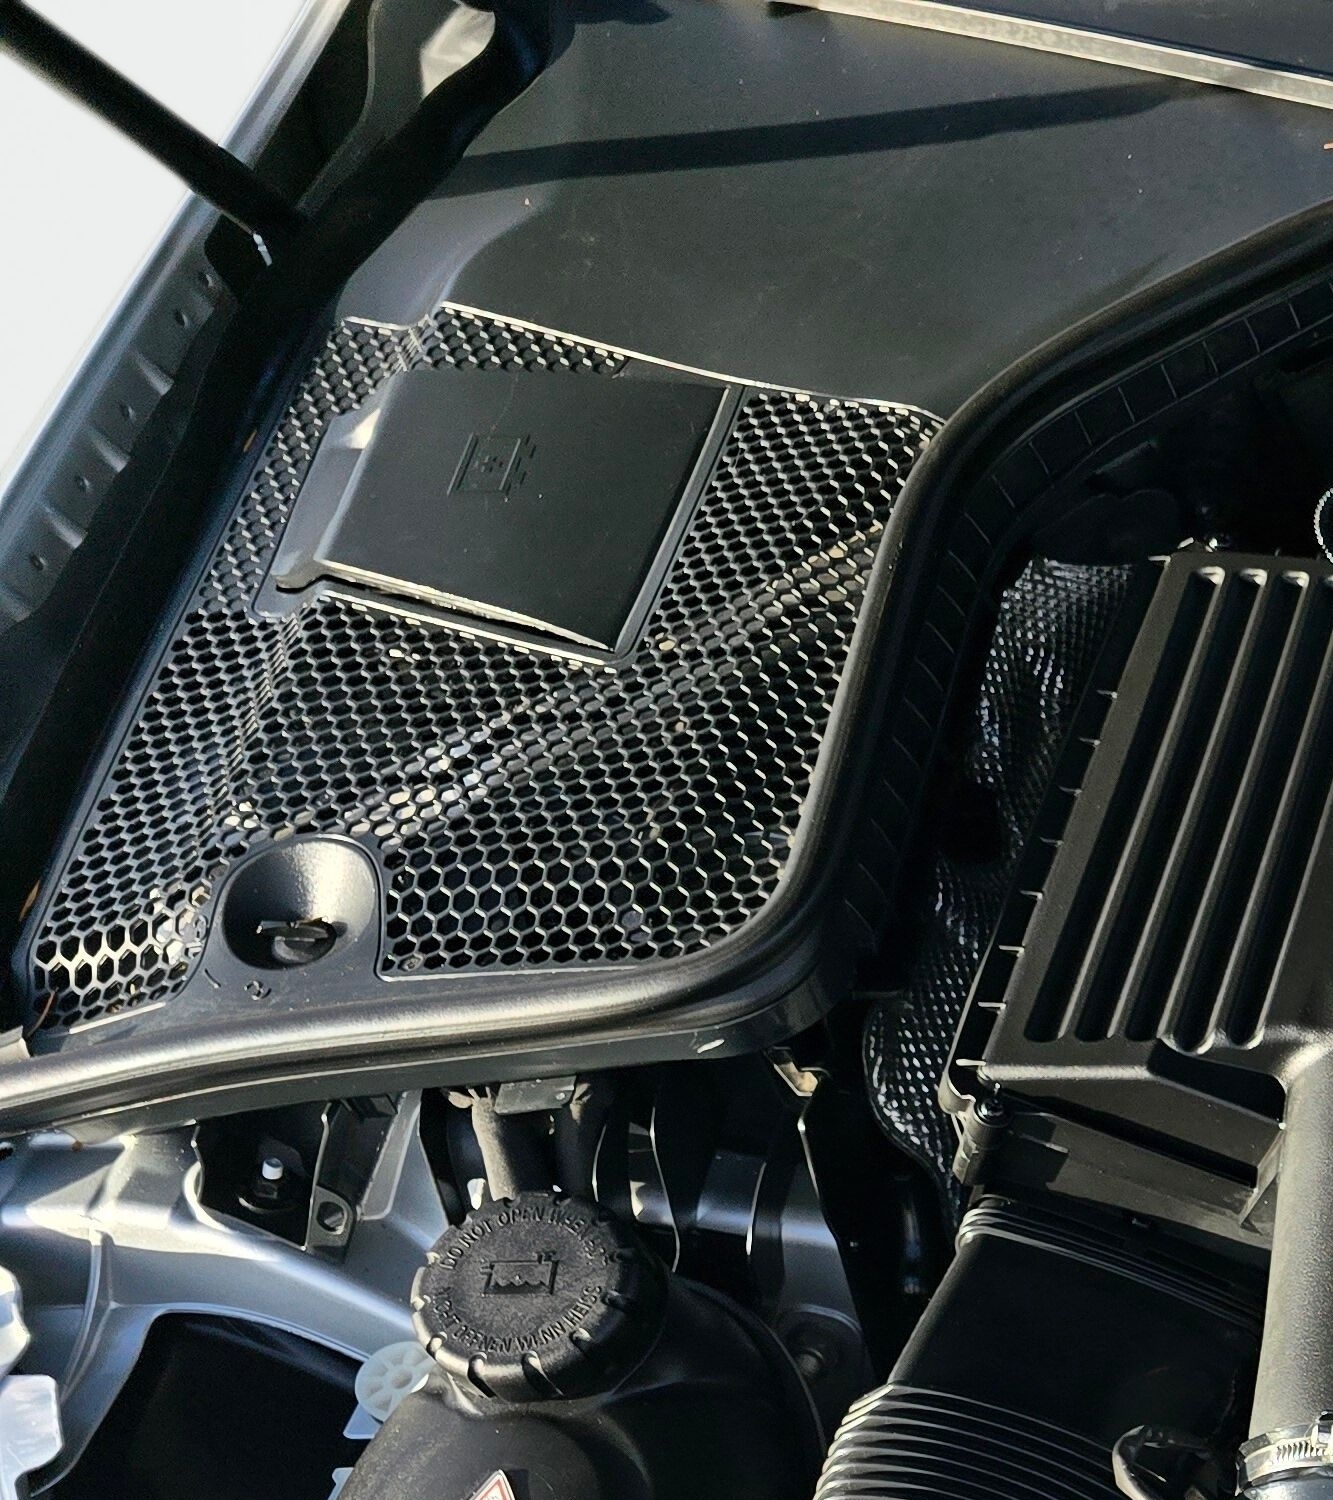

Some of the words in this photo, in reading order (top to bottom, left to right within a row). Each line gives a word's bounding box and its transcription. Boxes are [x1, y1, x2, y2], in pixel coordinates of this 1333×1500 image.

[440, 1246, 462, 1270] DO
[457, 1219, 493, 1250] NOT
[498, 1206, 546, 1227] OPEN
